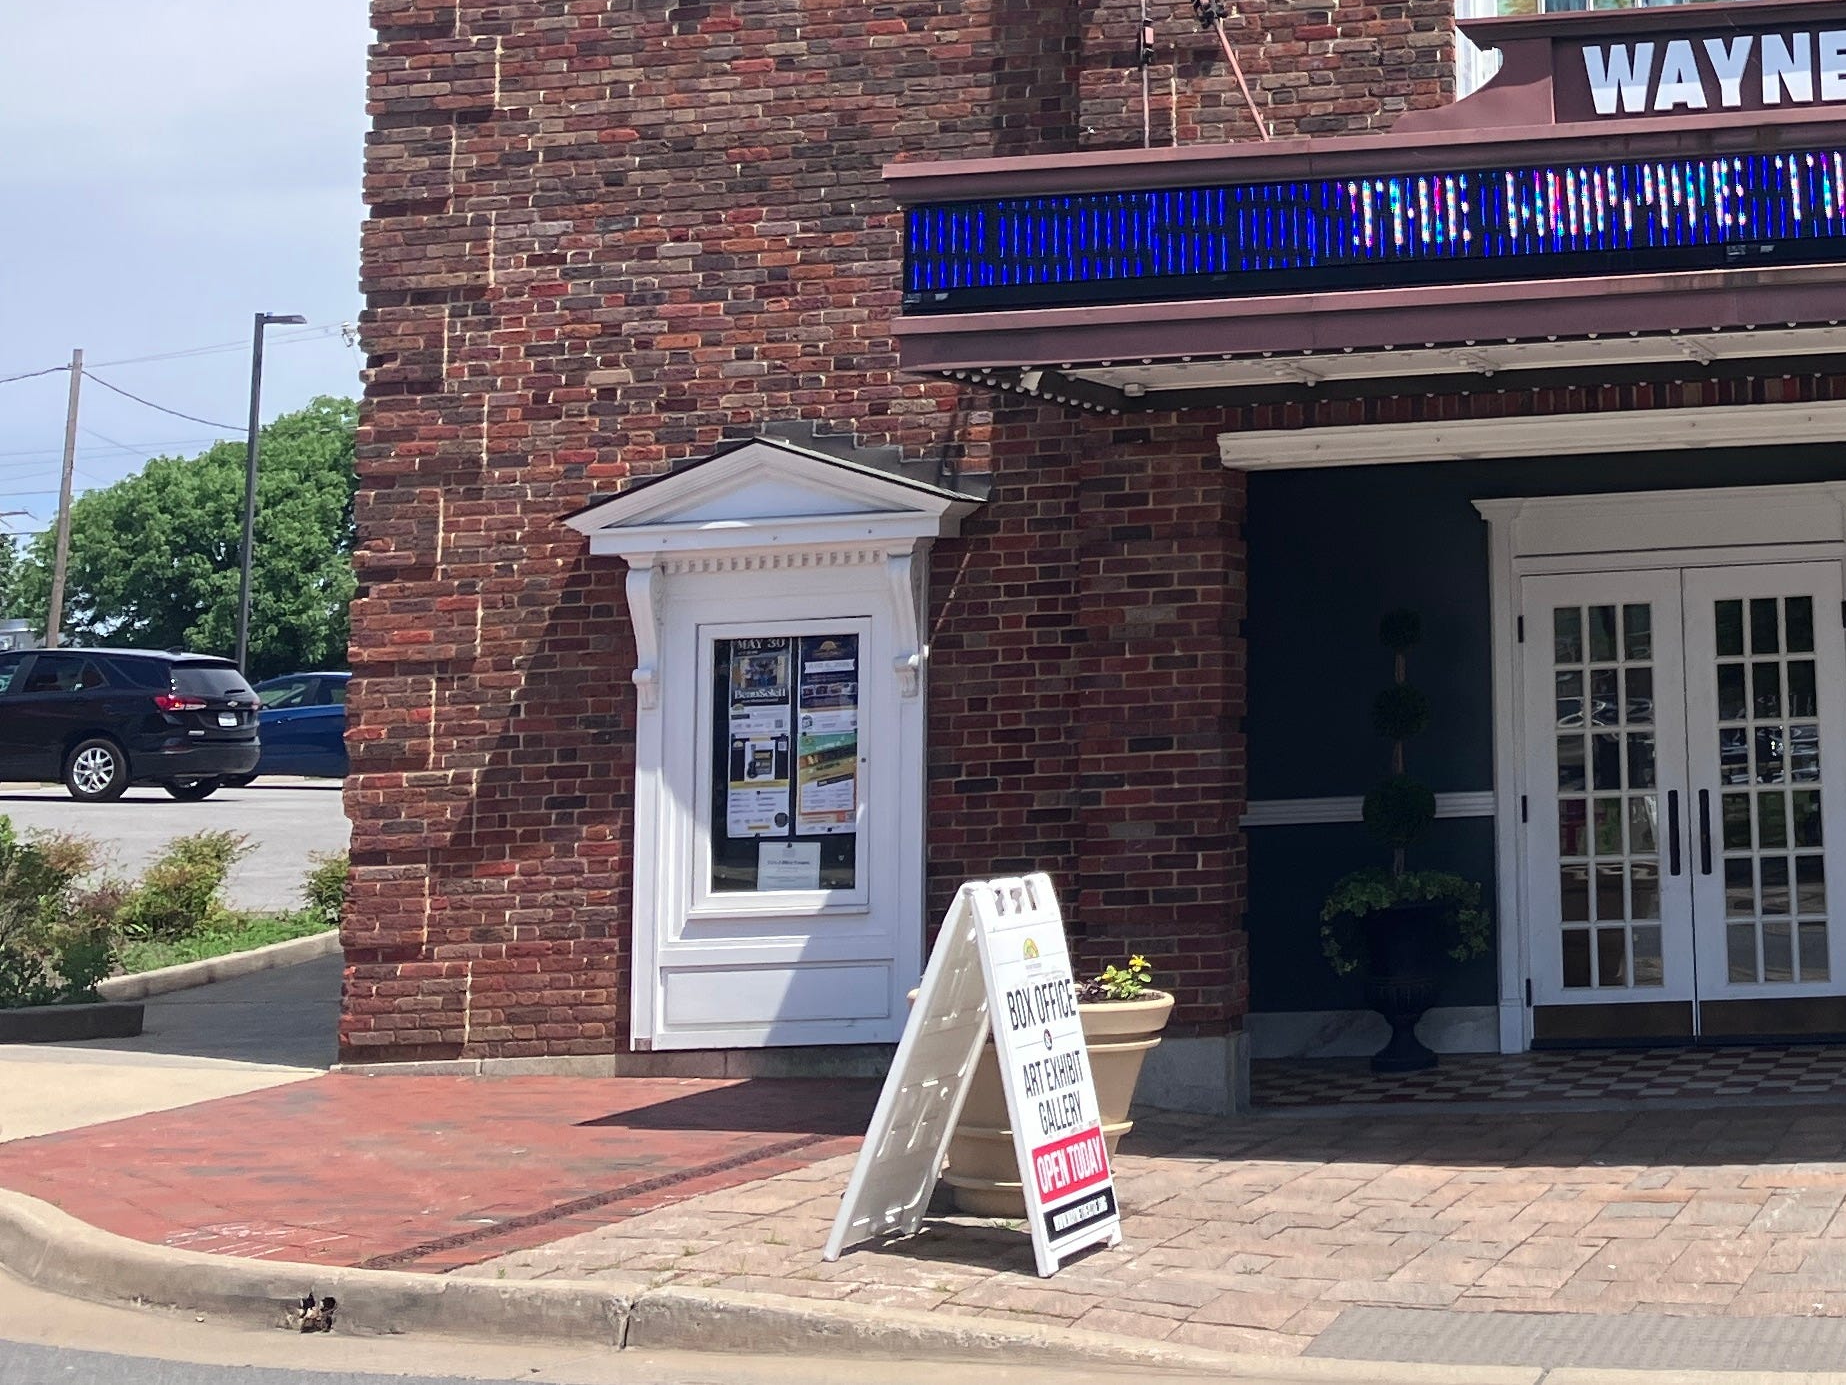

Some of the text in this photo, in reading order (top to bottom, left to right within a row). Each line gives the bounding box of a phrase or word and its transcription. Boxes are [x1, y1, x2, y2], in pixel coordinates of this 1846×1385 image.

[1347, 173, 1472, 247] THE
[738, 638, 763, 649] MAY
[1006, 978, 1077, 1031] BOX OFFICE
[1022, 1050, 1084, 1099] ART EXHIBIT
[1038, 1090, 1084, 1136] GALLERY
[1036, 1135, 1104, 1194] OPEN TODAY
